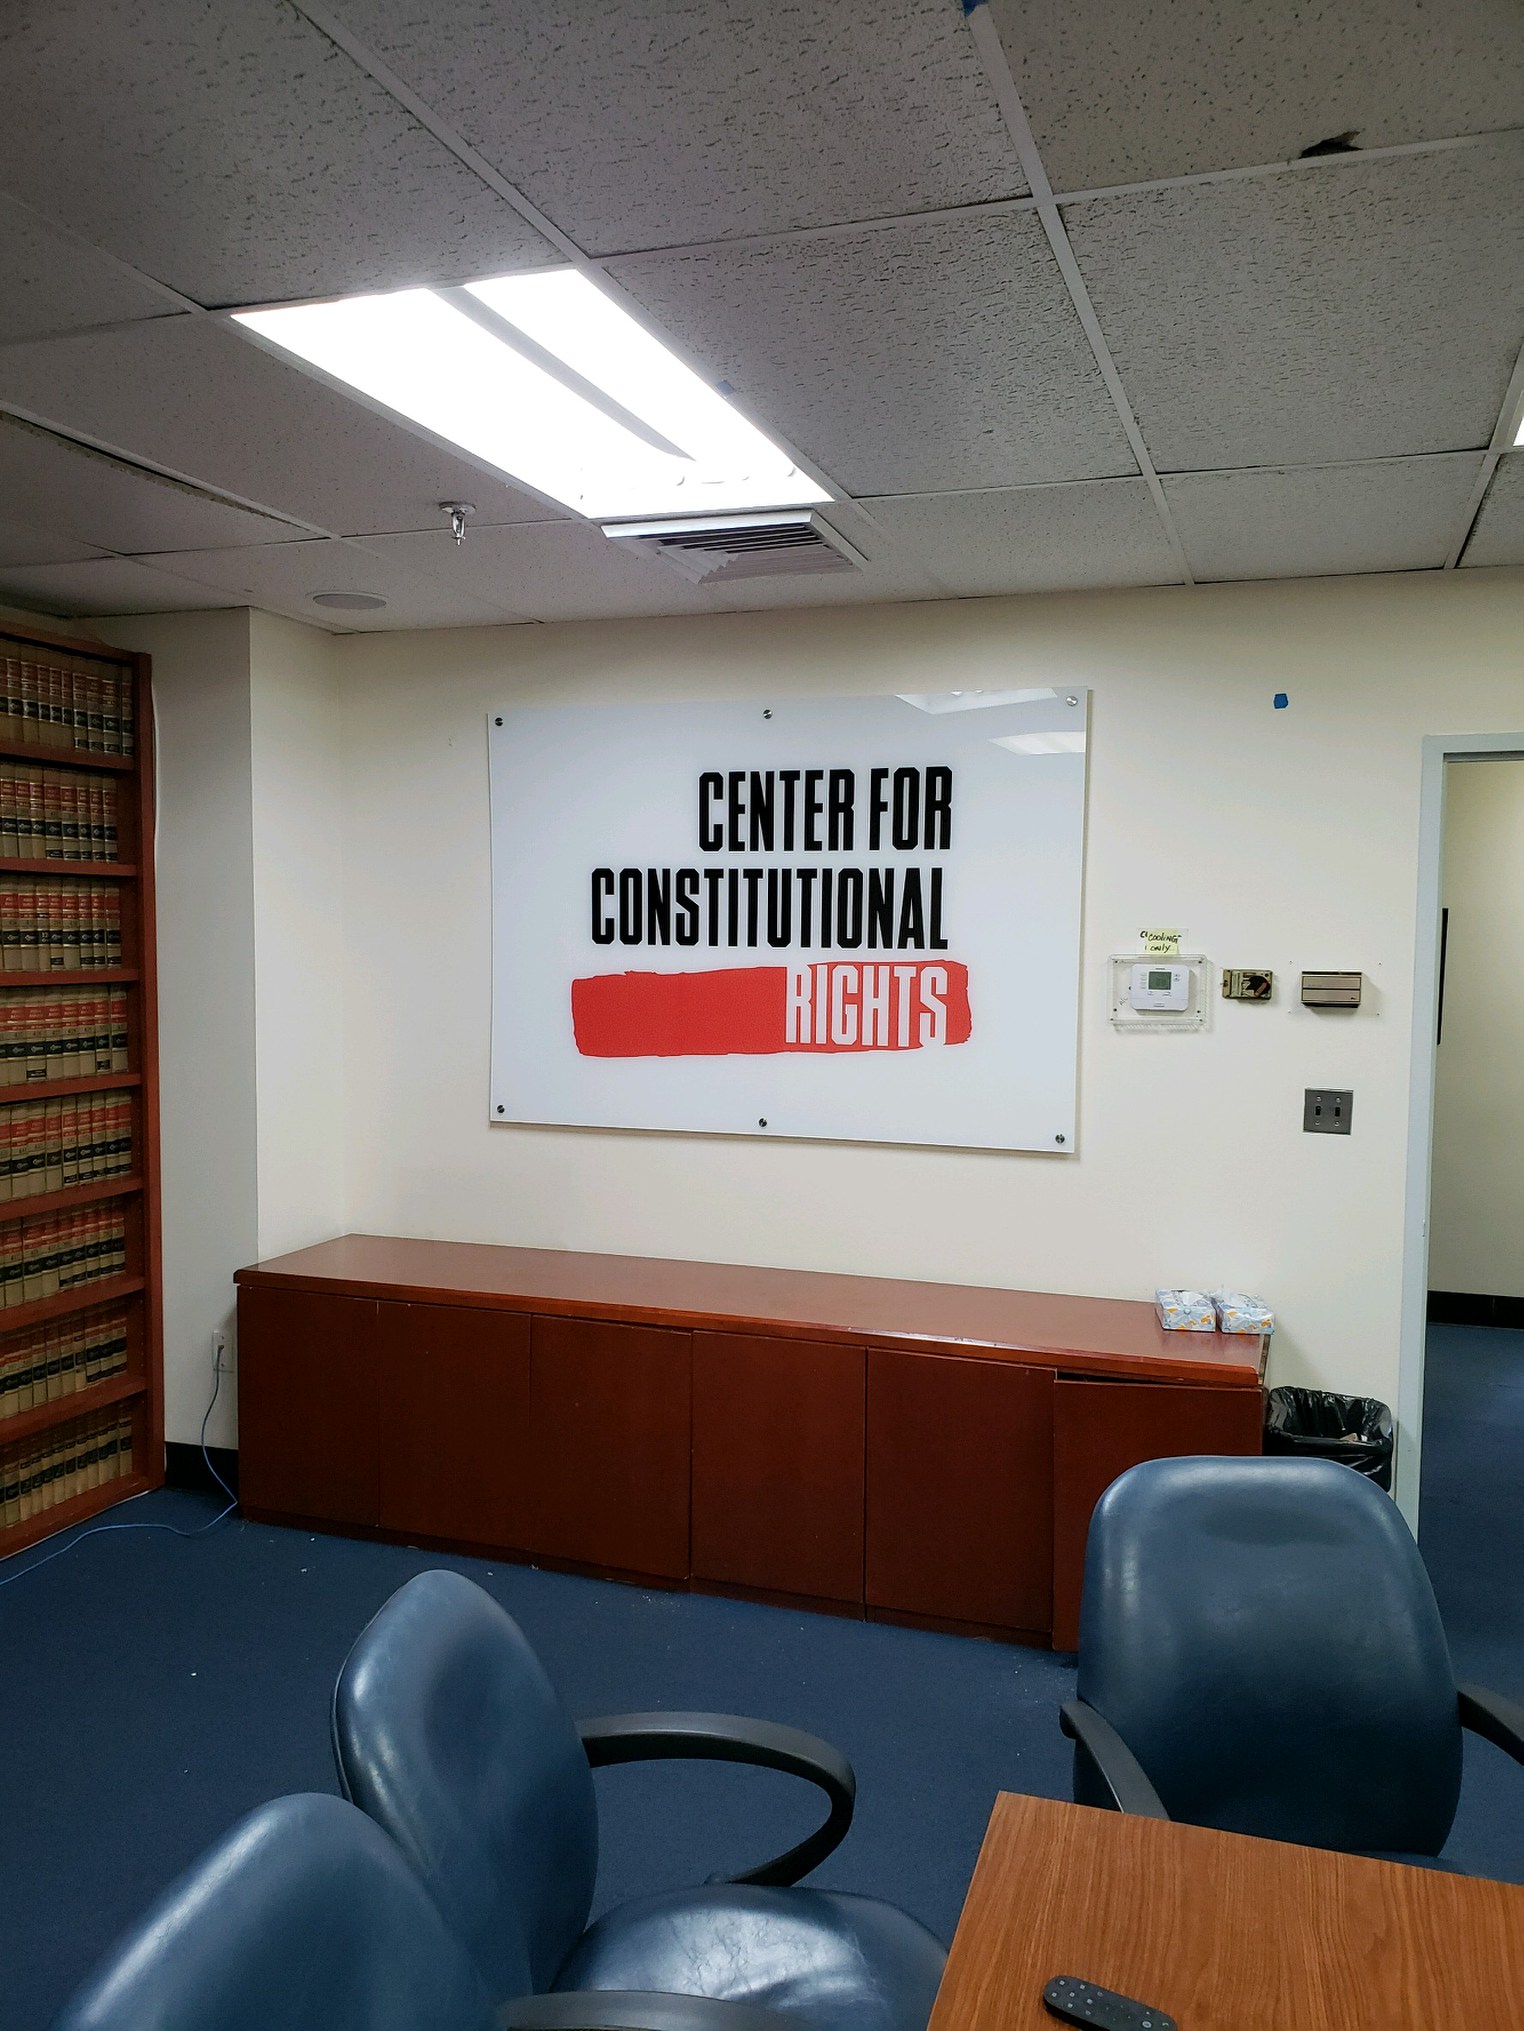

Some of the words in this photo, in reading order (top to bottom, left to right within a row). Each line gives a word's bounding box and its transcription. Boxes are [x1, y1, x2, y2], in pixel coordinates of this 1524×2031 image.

[698, 768, 856, 852] CENTER
[868, 765, 954, 851] FOR
[591, 867, 949, 950] CONSTITUTIONAL
[785, 964, 948, 1047] RIGHTS
